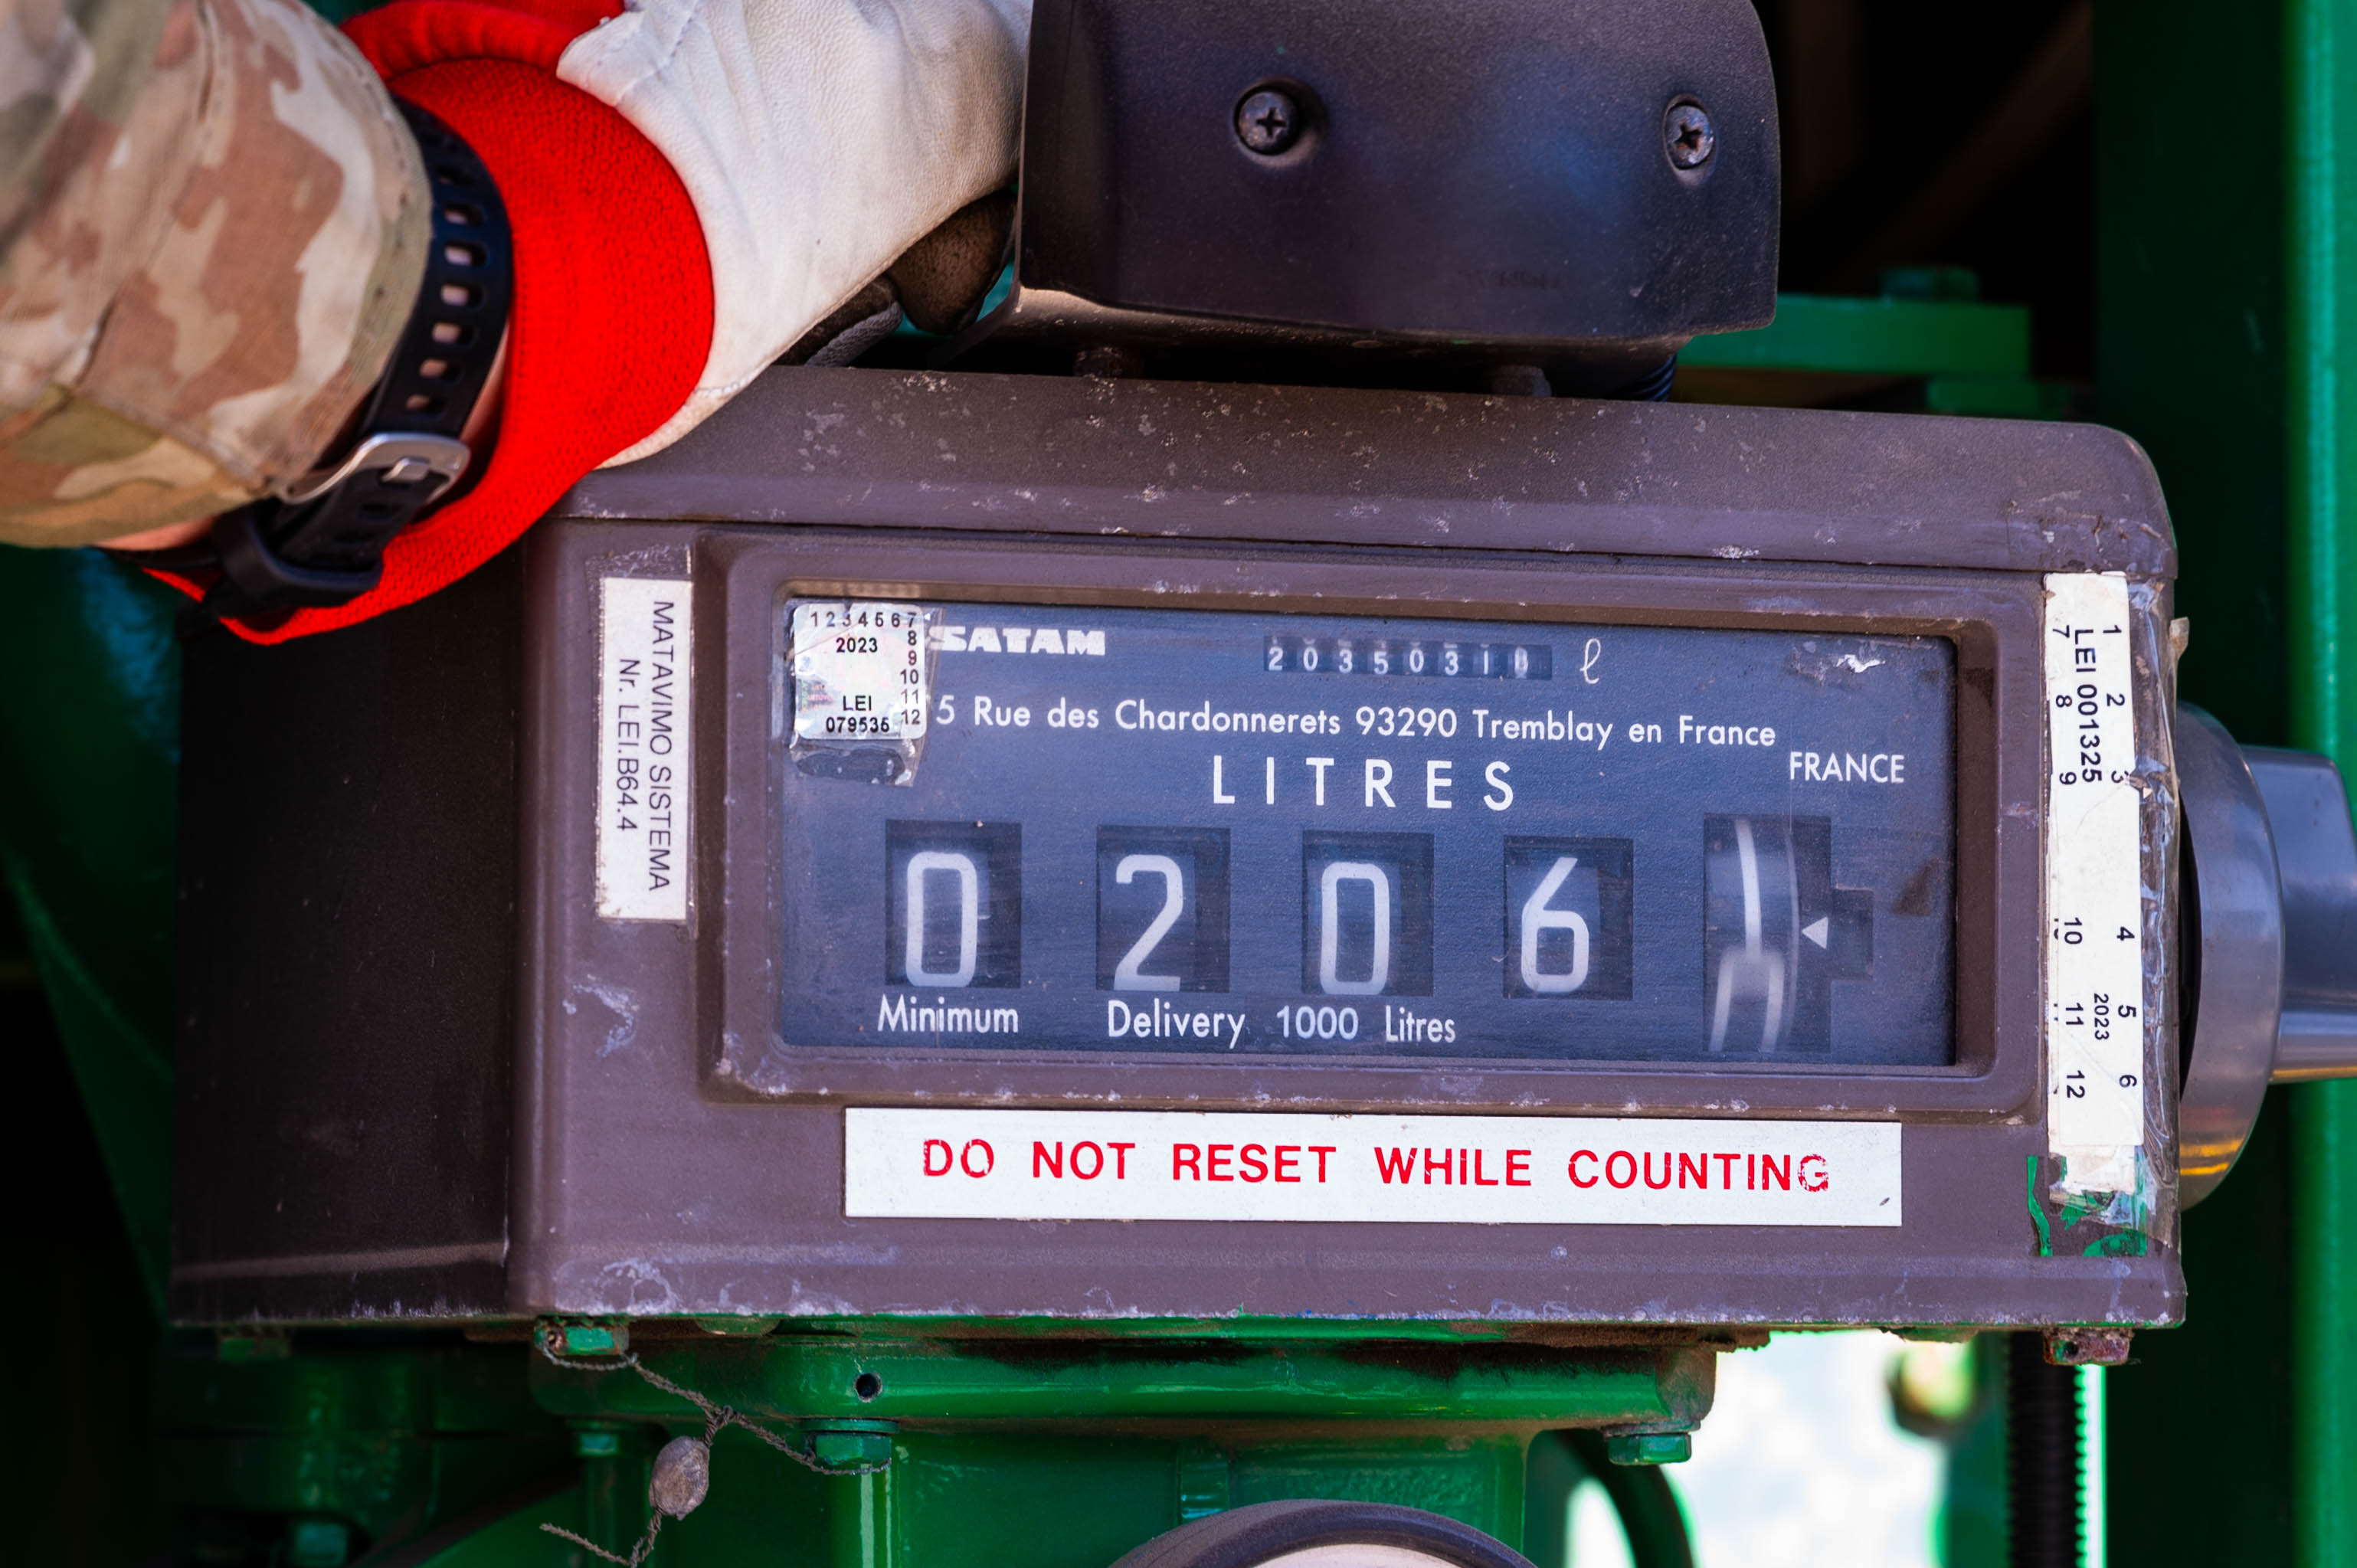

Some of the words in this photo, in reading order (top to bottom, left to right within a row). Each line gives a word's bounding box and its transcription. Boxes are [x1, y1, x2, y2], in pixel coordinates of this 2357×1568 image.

[810, 612, 818, 627] 1
[826, 612, 836, 627] 2
[858, 612, 869, 627] 4
[875, 612, 884, 627] 5
[891, 612, 900, 627] 6
[908, 612, 917, 627] 7
[2103, 625, 2122, 633] 1
[907, 630, 917, 646] 8
[928, 626, 1106, 656] SATAM
[2053, 625, 2070, 638] 7
[836, 637, 878, 653] 2023
[2074, 630, 2096, 673] LEI
[907, 650, 917, 666] 9
[619, 659, 640, 692] Nr.
[649, 601, 673, 756] MATAVIMO
[900, 669, 919, 685] 10
[843, 696, 872, 712] LEI
[2056, 695, 2073, 708] 8
[2107, 694, 2125, 706] 2
[901, 709, 920, 725] 12
[974, 696, 1030, 726] Rue
[1047, 698, 1099, 728] des
[1115, 700, 1341, 735] Chardonnerets
[1355, 706, 1457, 737] 93290
[1472, 709, 1613, 750] Tremblay
[1629, 723, 1662, 743] en
[1679, 715, 1776, 746] France
[2077, 684, 2102, 783] 001325
[617, 705, 640, 832] LEI.B64.4
[1789, 751, 1905, 783] FRANCE
[2059, 771, 2077, 785] 9
[1213, 755, 1514, 810] LITRES
[649, 765, 672, 891] SISTEMA
[2064, 918, 2083, 944] 10
[2116, 926, 2135, 941] 4
[877, 994, 1019, 1033] Minimum
[1108, 998, 1246, 1049] Delivery
[1276, 1006, 1359, 1040] 1000
[1385, 1006, 1455, 1043] Litres
[2065, 1003, 2084, 1026] 11
[2093, 994, 2110, 1041] 2023
[2117, 1005, 2137, 1018] 5
[2067, 1070, 2085, 1098] 12
[2120, 1074, 2138, 1088] 6
[924, 1138, 994, 1178] DO
[1033, 1141, 1135, 1180] NOT
[1173, 1144, 1337, 1183] RESET
[1374, 1147, 1532, 1187] WHILE
[1568, 1149, 1830, 1192] COUNTING
